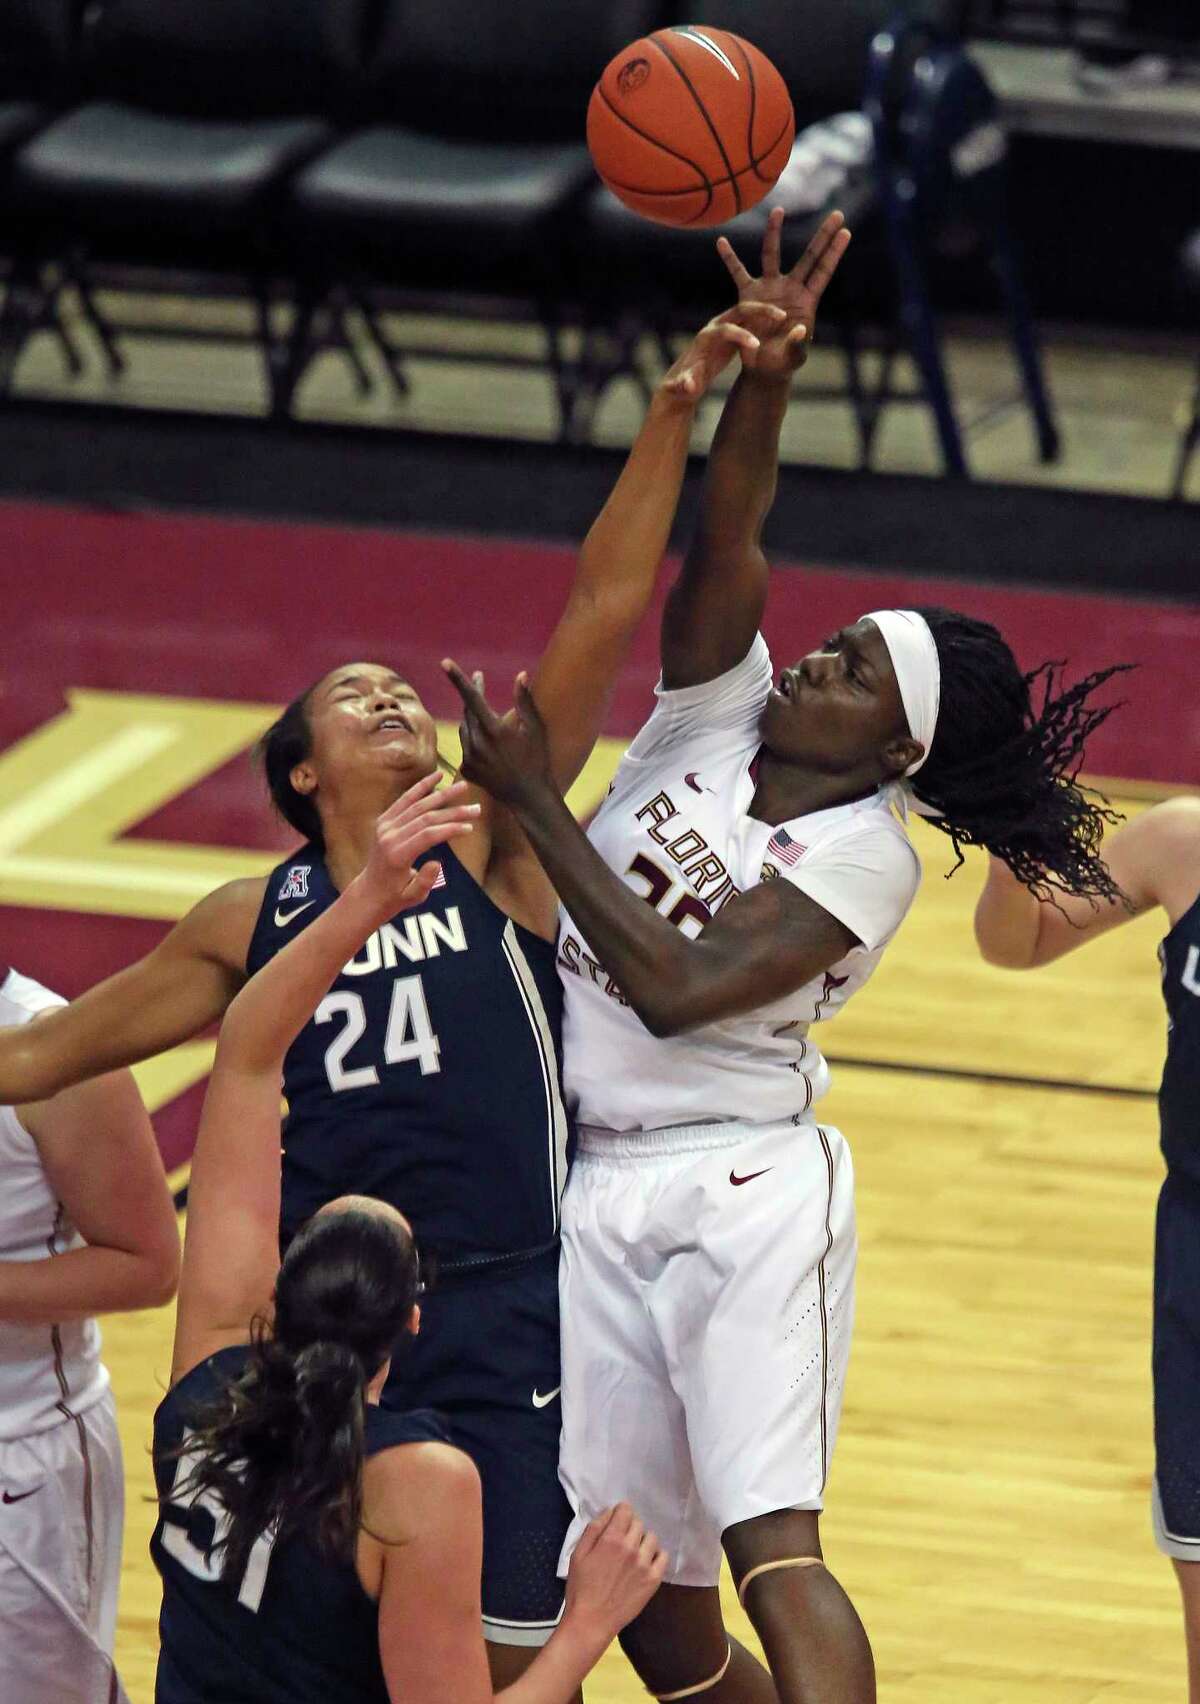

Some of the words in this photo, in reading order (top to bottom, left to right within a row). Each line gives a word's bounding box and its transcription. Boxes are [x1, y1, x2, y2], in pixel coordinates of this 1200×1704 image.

[634, 789, 743, 915] FLORI
[557, 934, 630, 1007] STA
[313, 973, 441, 1093] 24
